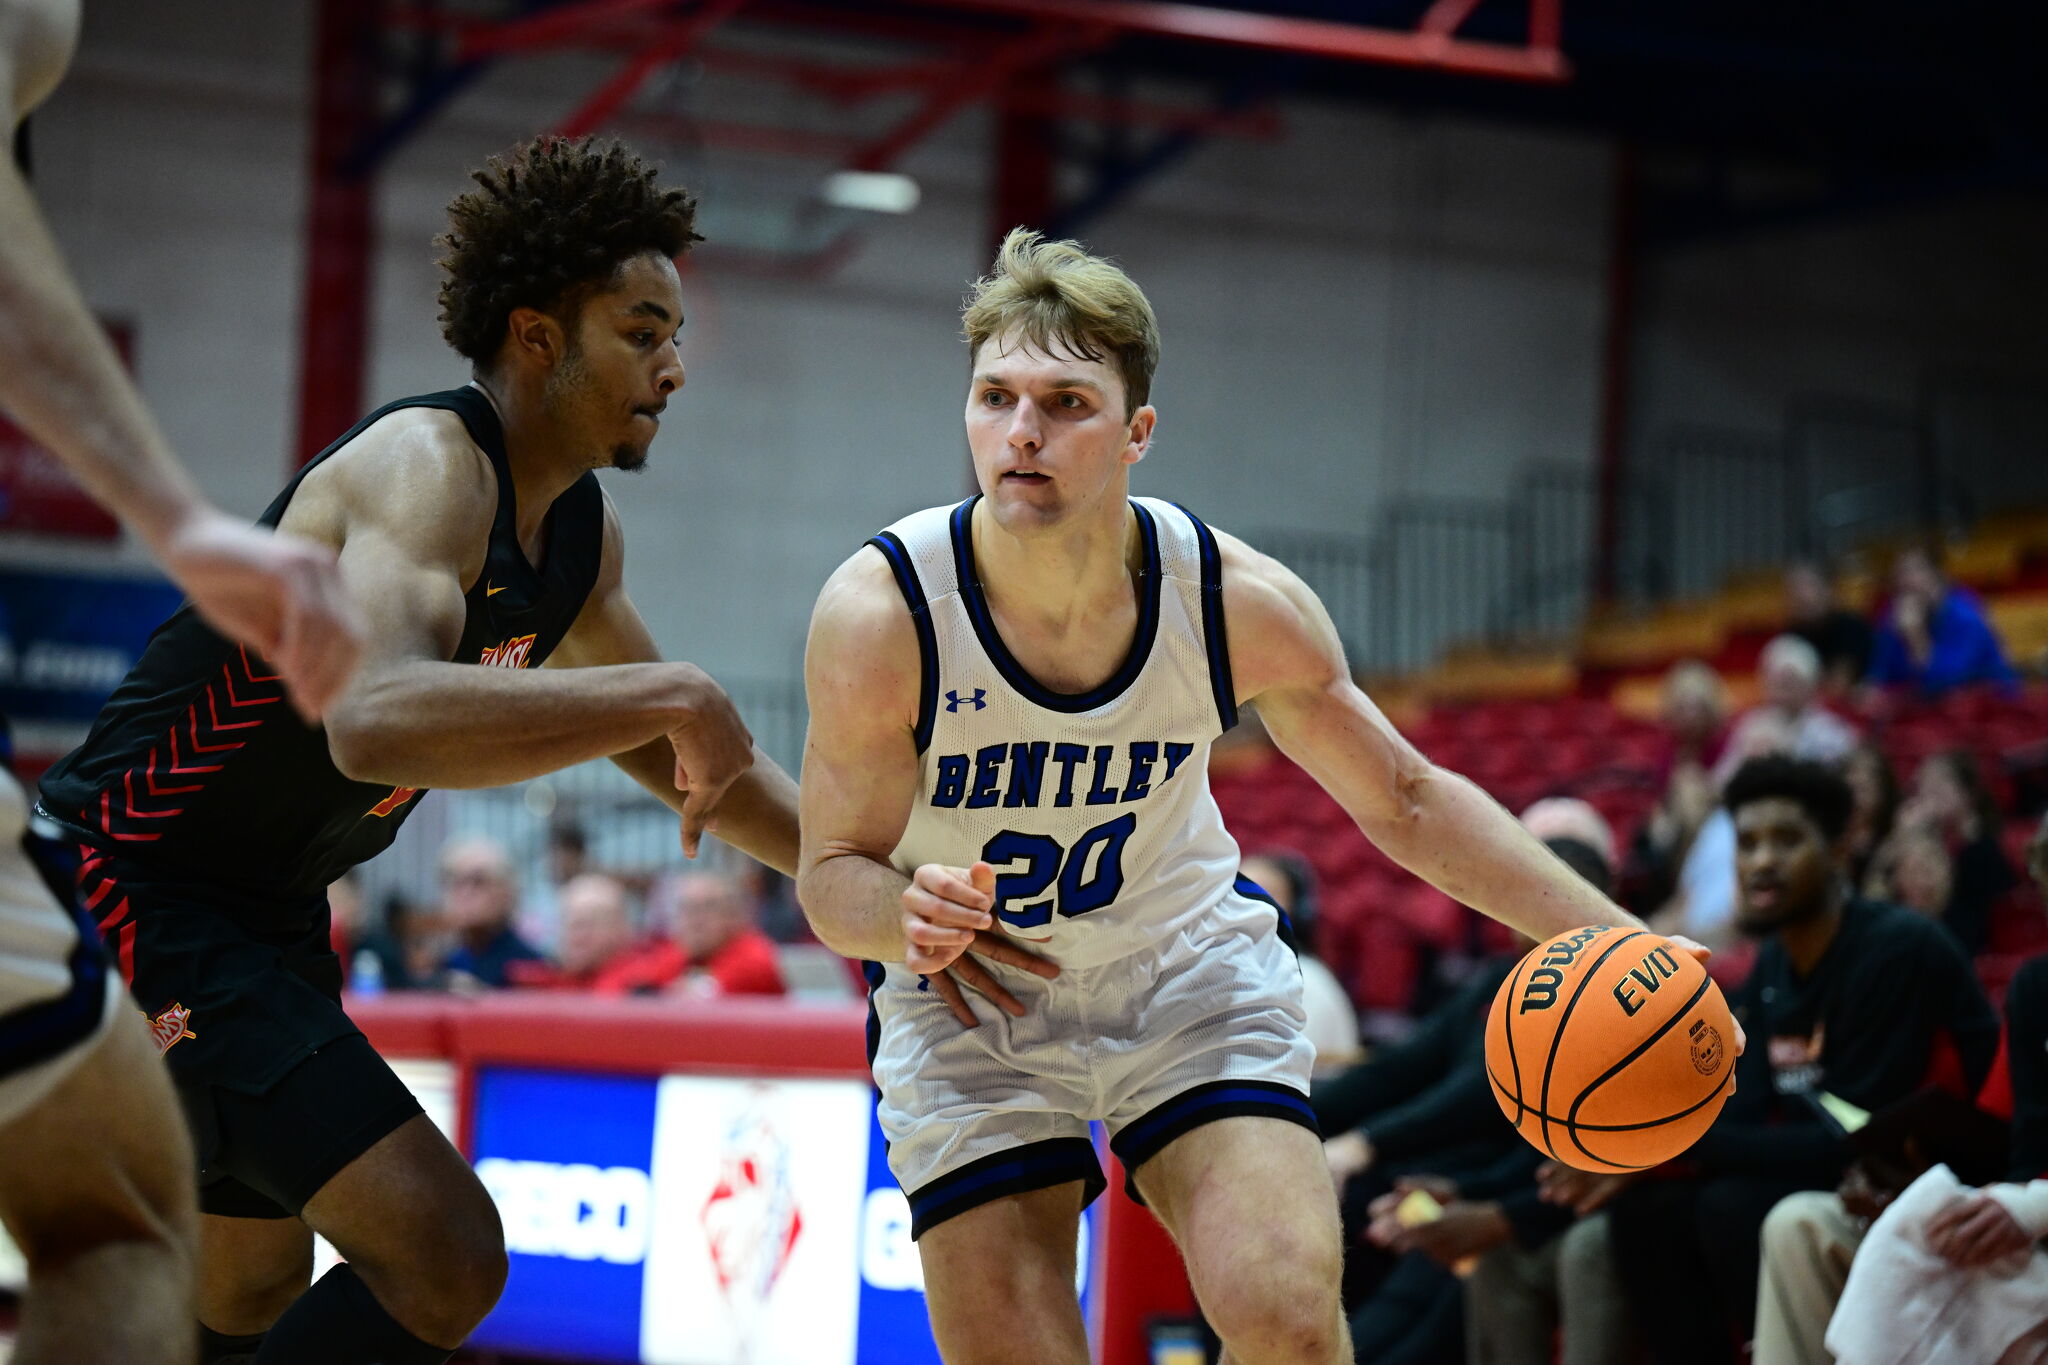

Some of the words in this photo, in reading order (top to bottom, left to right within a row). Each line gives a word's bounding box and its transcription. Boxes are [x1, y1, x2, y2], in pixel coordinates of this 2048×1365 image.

[930, 741, 1195, 809] BENTLEY
[981, 811, 1137, 929] 20
[1519, 924, 1611, 1016] Wilso
[1611, 945, 1680, 1018] EVO
